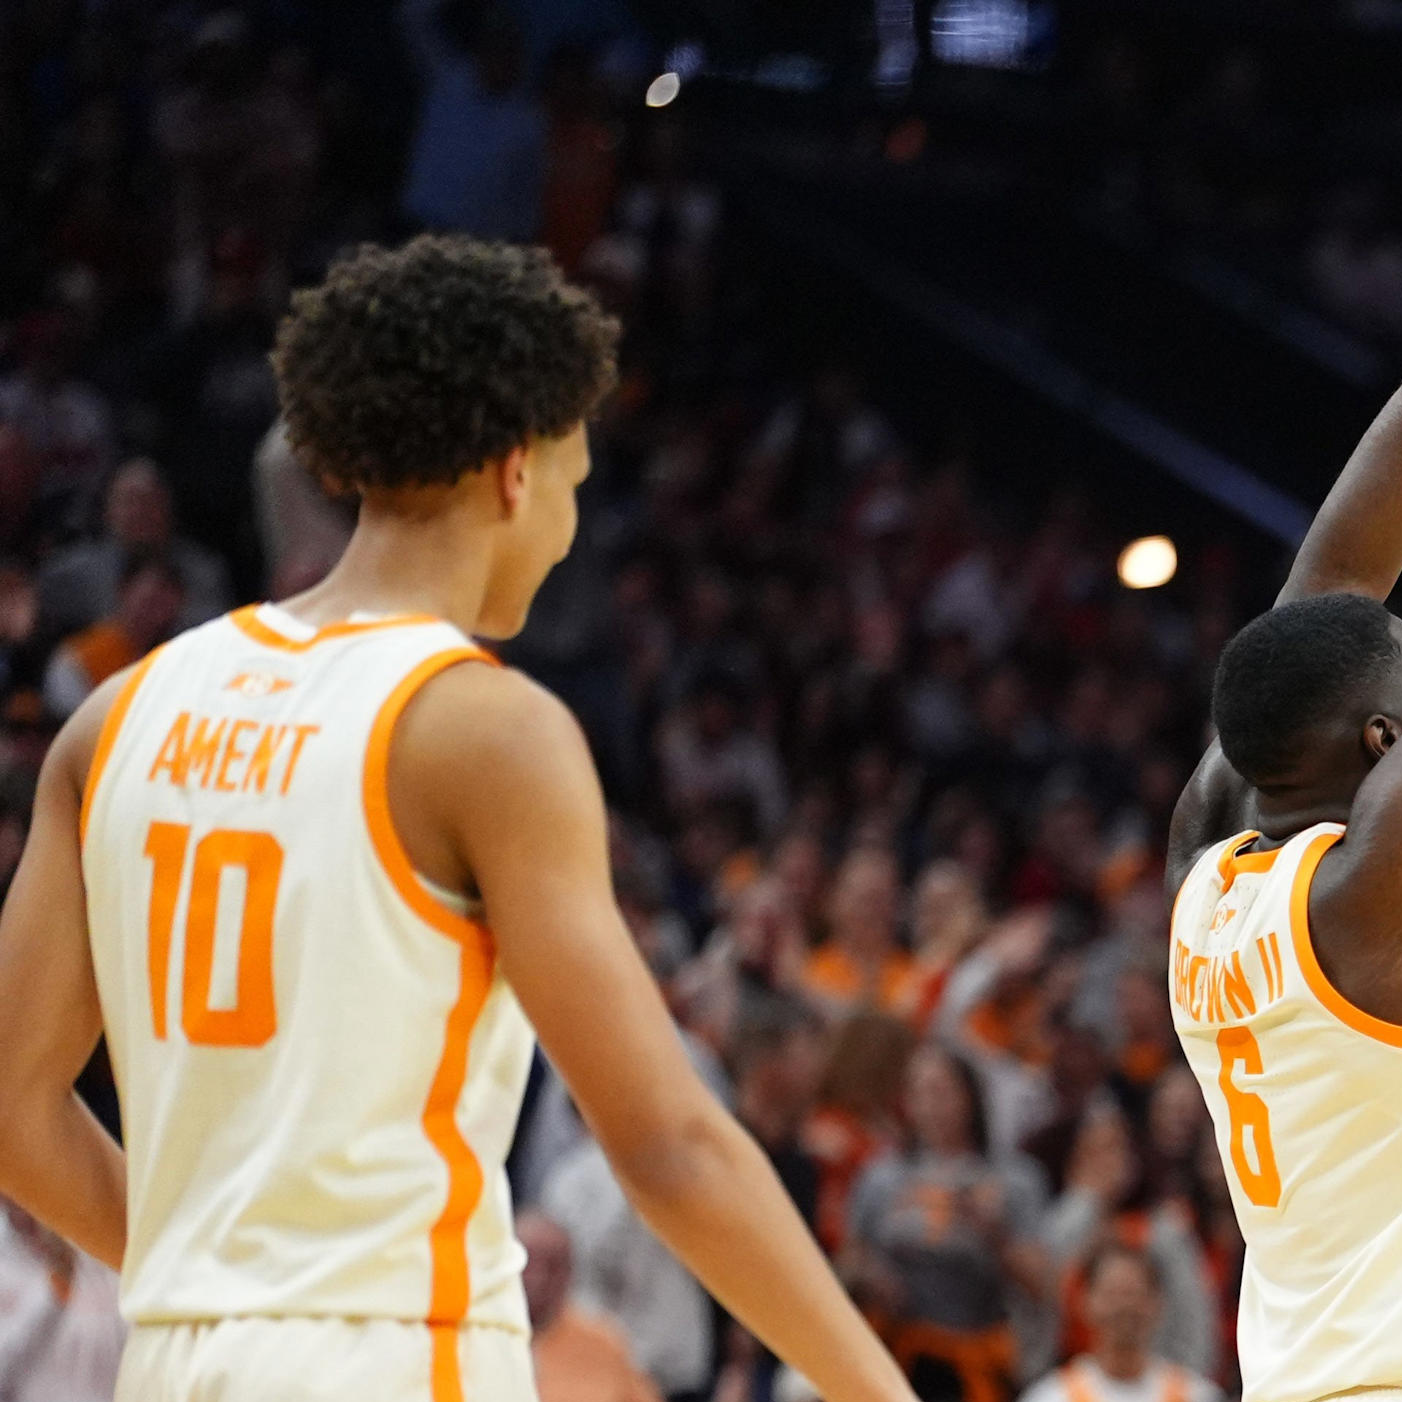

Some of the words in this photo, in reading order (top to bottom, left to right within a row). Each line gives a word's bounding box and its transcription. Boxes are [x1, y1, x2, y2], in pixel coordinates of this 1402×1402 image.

[147, 711, 321, 797] AMENT
[143, 820, 285, 1049] 10
[1255, 931, 1284, 1005] II
[1215, 1025, 1282, 1209] 6
